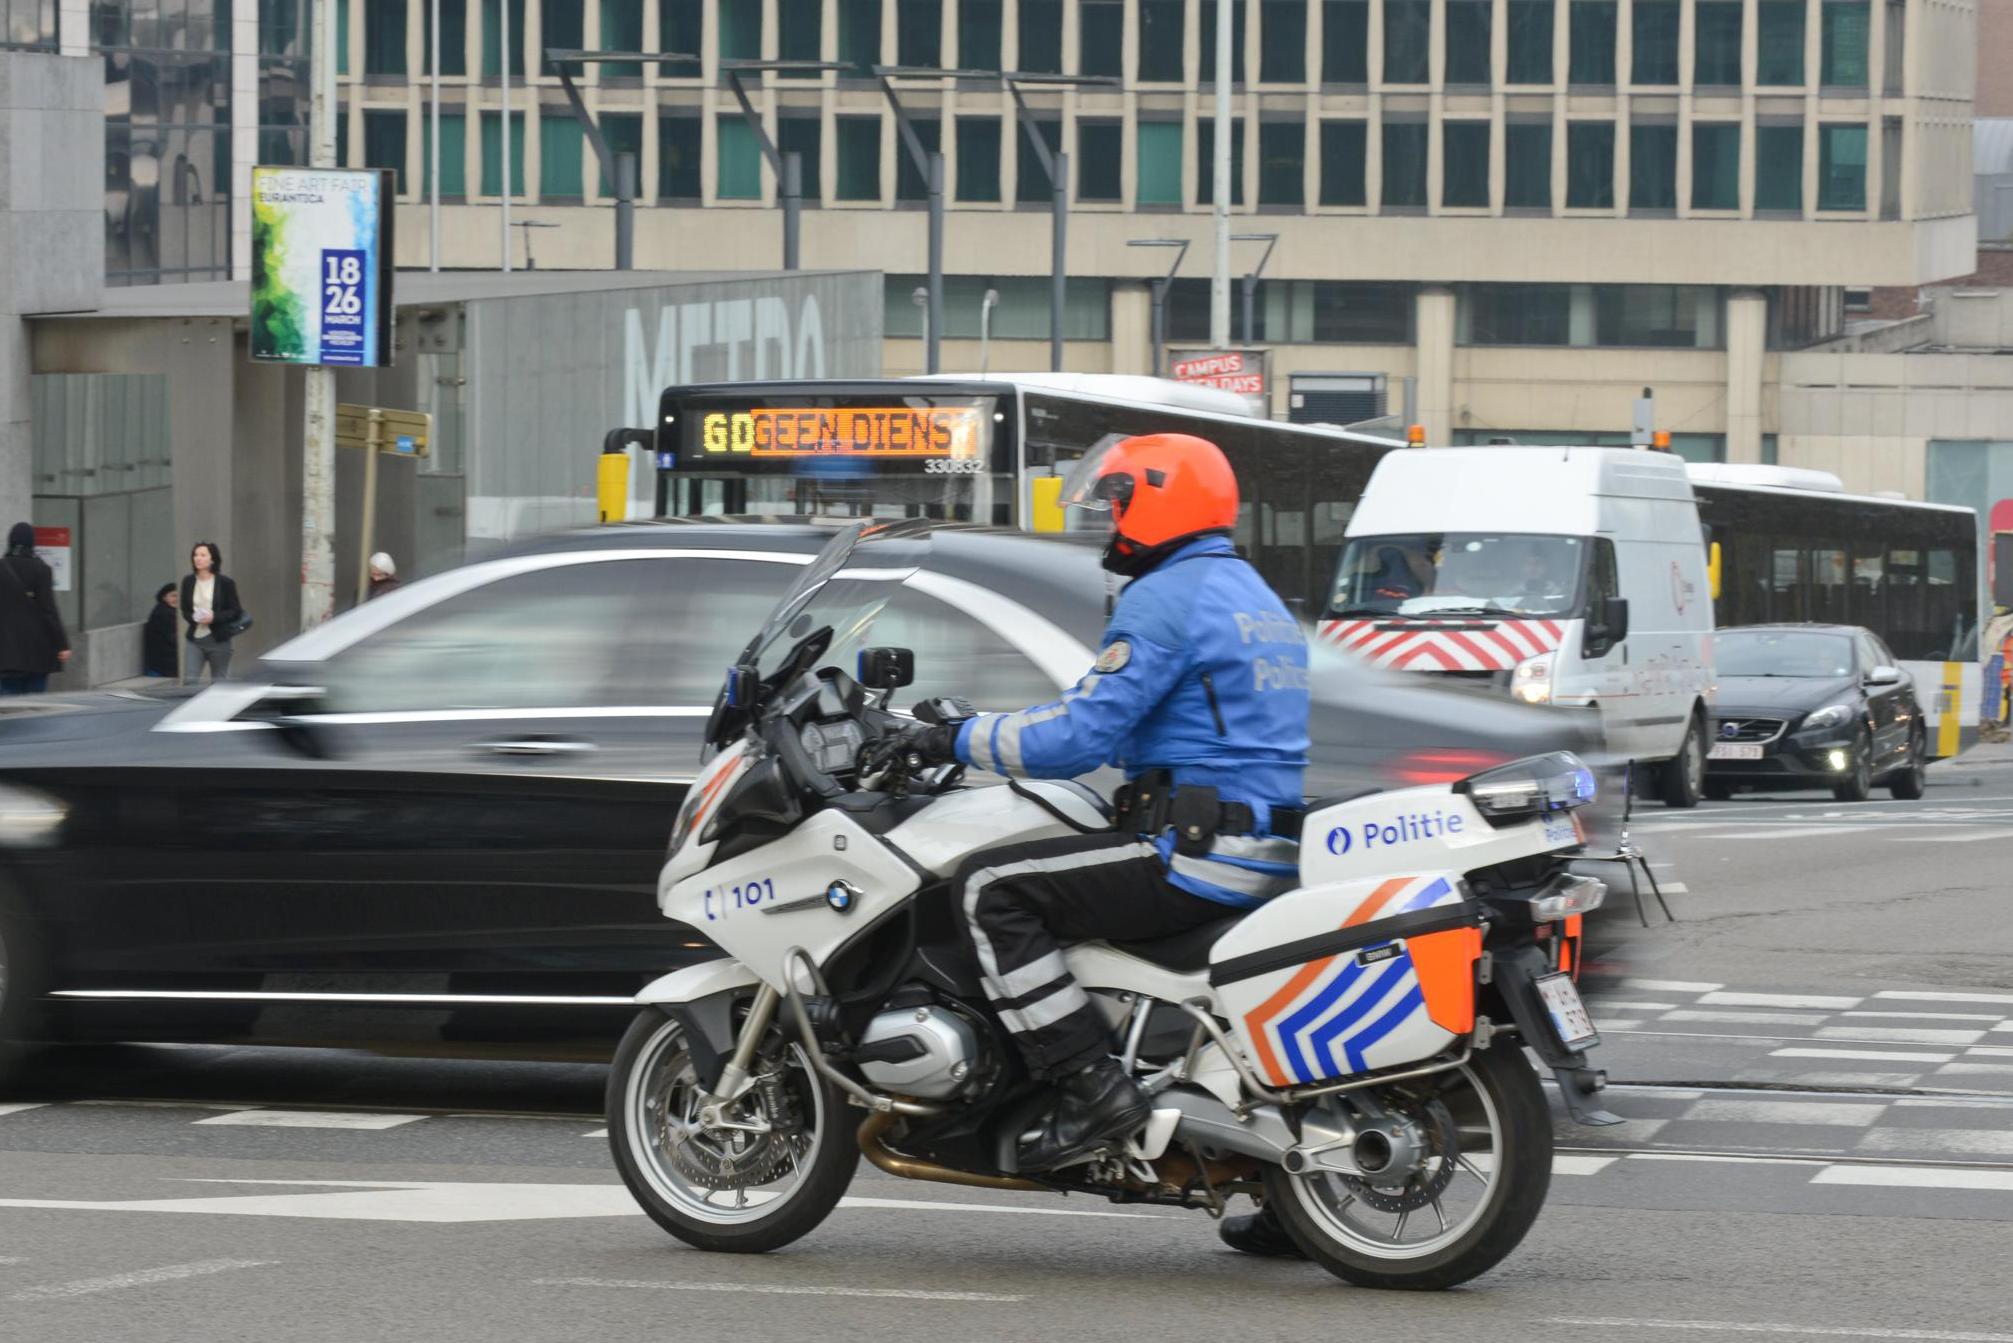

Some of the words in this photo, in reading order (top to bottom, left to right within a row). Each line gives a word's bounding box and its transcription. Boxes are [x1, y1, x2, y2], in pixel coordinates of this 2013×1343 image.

[325, 256, 361, 285] 18
[325, 286, 361, 315] 26
[1175, 354, 1241, 379] CAMPUS
[754, 413, 838, 450] GEEN
[1363, 810, 1463, 848] Politie
[732, 878, 774, 908] 101
